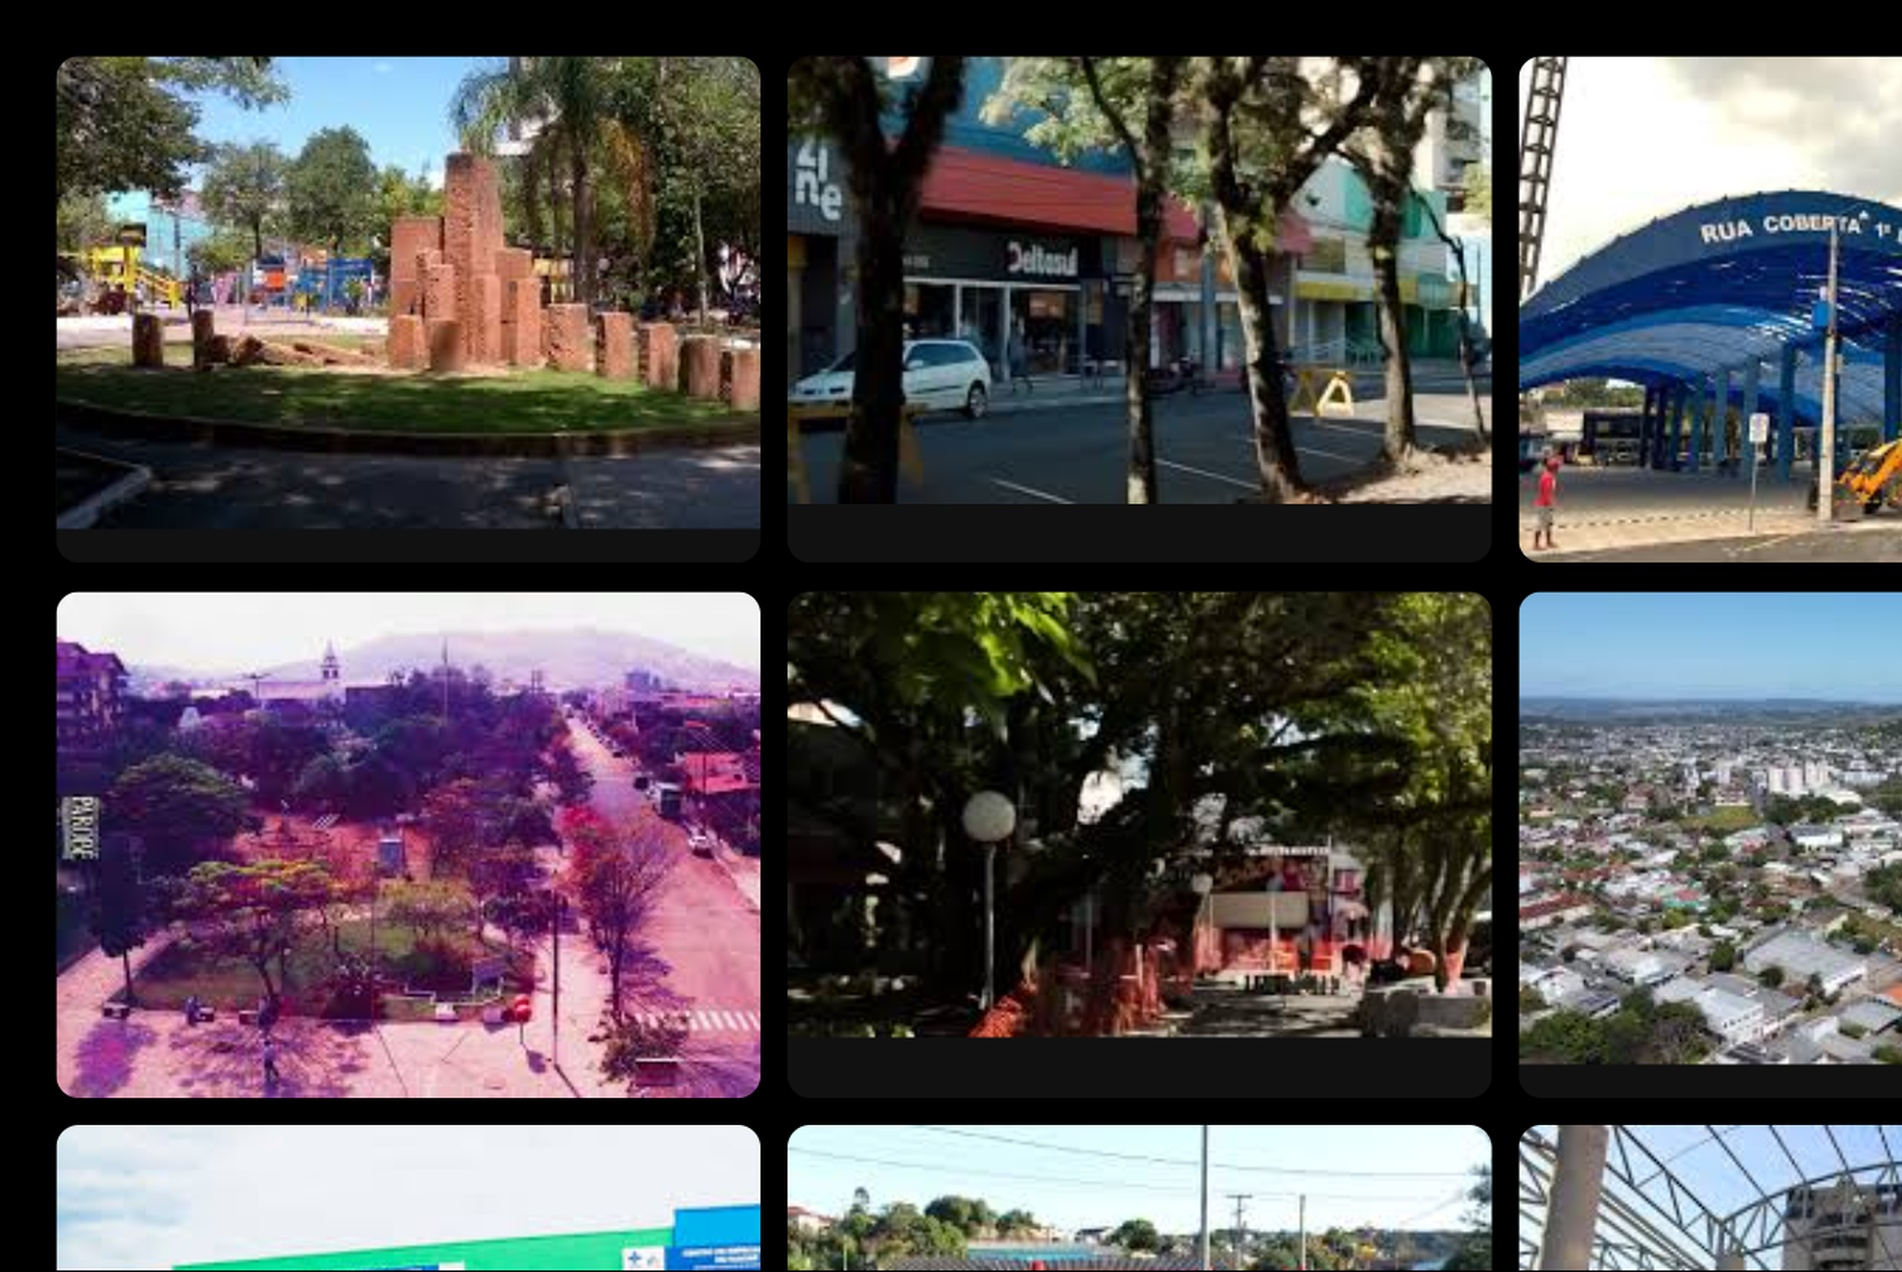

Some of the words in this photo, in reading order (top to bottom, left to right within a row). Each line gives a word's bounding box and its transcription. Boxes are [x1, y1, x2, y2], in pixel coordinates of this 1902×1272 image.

[1700, 220, 1754, 244] RUA
[1763, 213, 1861, 234] COBERTA
[1007, 240, 1079, 277] Deltasul
